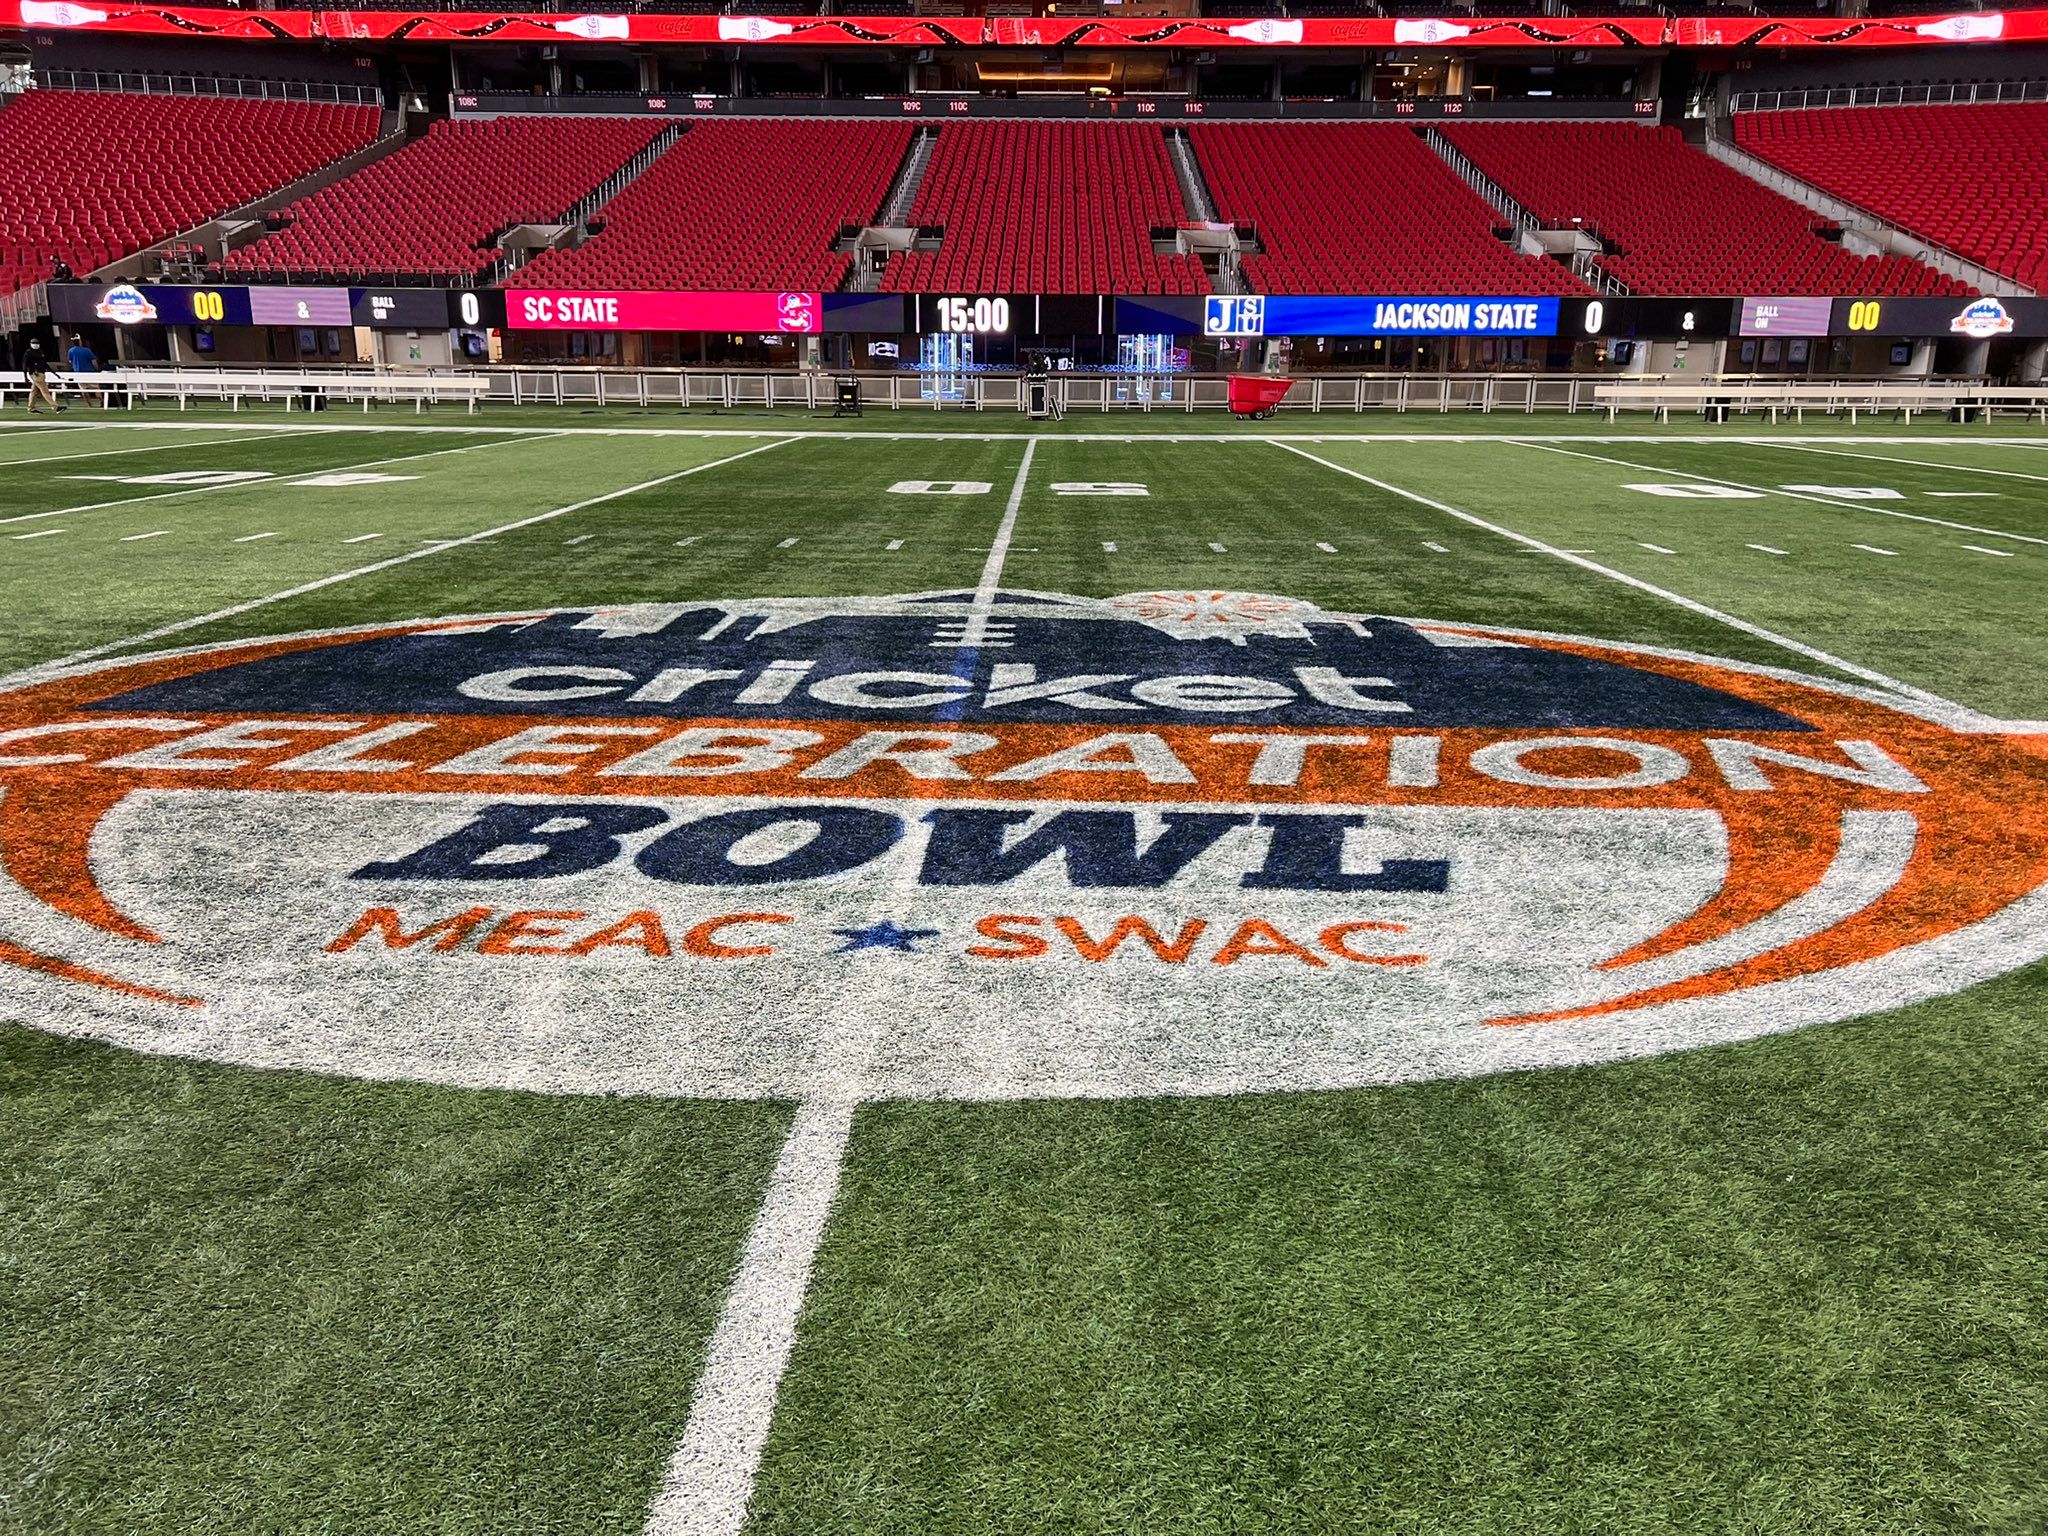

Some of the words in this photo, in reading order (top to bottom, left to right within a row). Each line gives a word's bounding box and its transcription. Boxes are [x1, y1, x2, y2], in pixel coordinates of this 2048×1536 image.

[355, 58, 371, 66] 107
[458, 98, 477, 107] 108C
[648, 99, 666, 108] 108C
[694, 100, 713, 109] 109C
[902, 101, 921, 111] 109C
[950, 101, 968, 111] 110C
[1137, 103, 1155, 112] 110C
[1184, 103, 1203, 112] 111C
[1396, 103, 1414, 113] 111C
[1444, 103, 1462, 113] 112C
[1634, 103, 1652, 113] 112C
[193, 291, 224, 320] 00
[372, 296, 396, 308] BALL
[298, 301, 310, 319] &
[373, 308, 387, 319] ON
[461, 292, 479, 325] 0
[523, 296, 552, 322] SC
[557, 297, 619, 322] STATE
[936, 297, 1009, 332] 15:00
[1756, 305, 1779, 317] BALL
[1373, 303, 1470, 329] JACKSON
[1474, 304, 1538, 330] STATE
[1585, 301, 1603, 333] 0
[1682, 312, 1695, 330] &
[1848, 301, 1880, 331] 00
[1755, 317, 1769, 328] ON
[456, 660, 1414, 713] cricket
[0, 718, 1931, 793] CELEBRATION
[348, 803, 1450, 893] BOWL
[323, 907, 794, 957] MEAC
[966, 914, 1430, 967] SWAC
